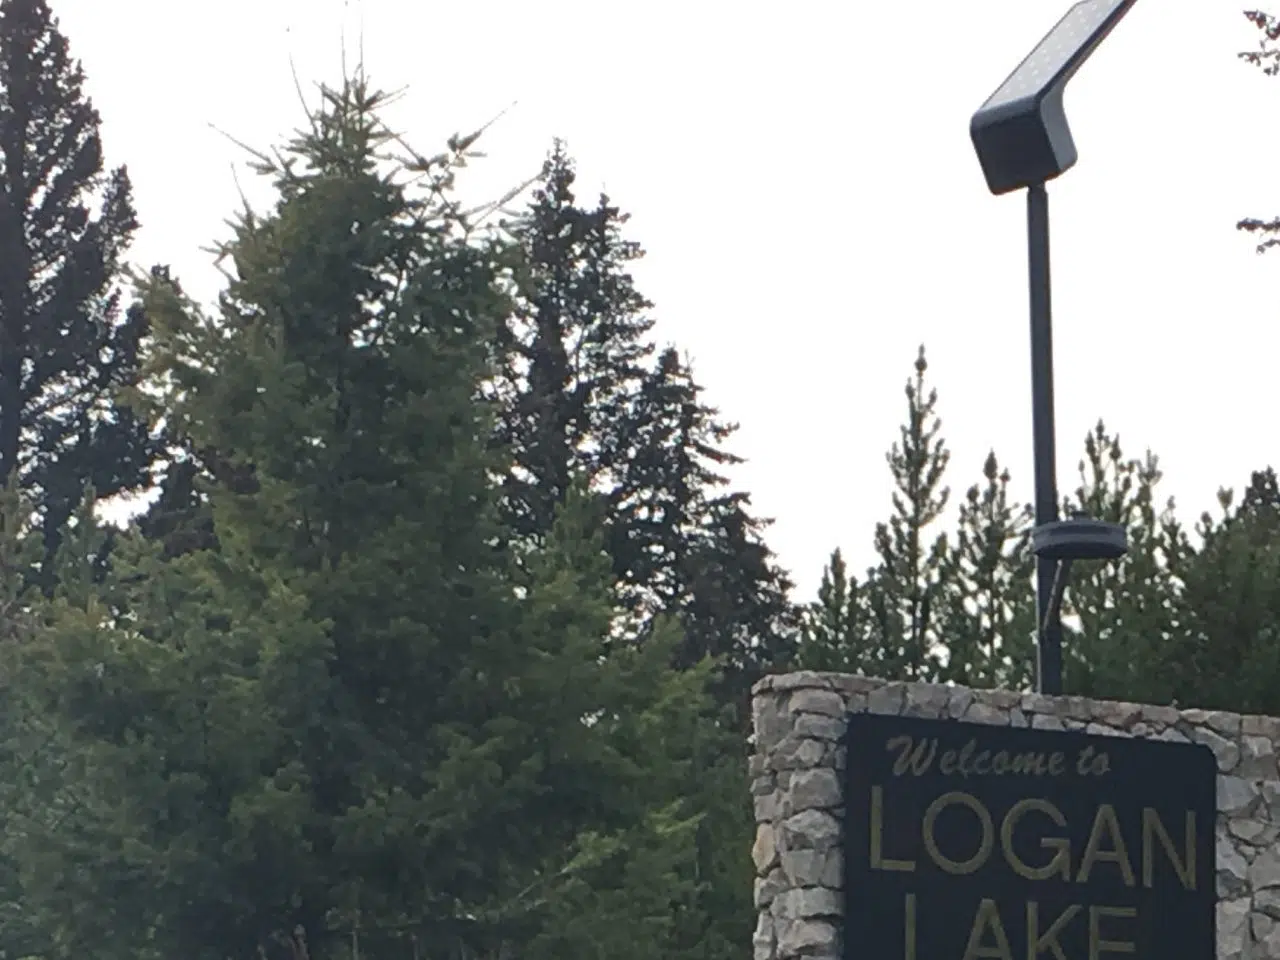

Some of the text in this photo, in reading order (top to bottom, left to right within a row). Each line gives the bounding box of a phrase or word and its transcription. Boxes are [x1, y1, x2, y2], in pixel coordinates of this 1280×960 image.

[885, 736, 1112, 777] Welcome to
[869, 785, 1197, 890] LOGAN
